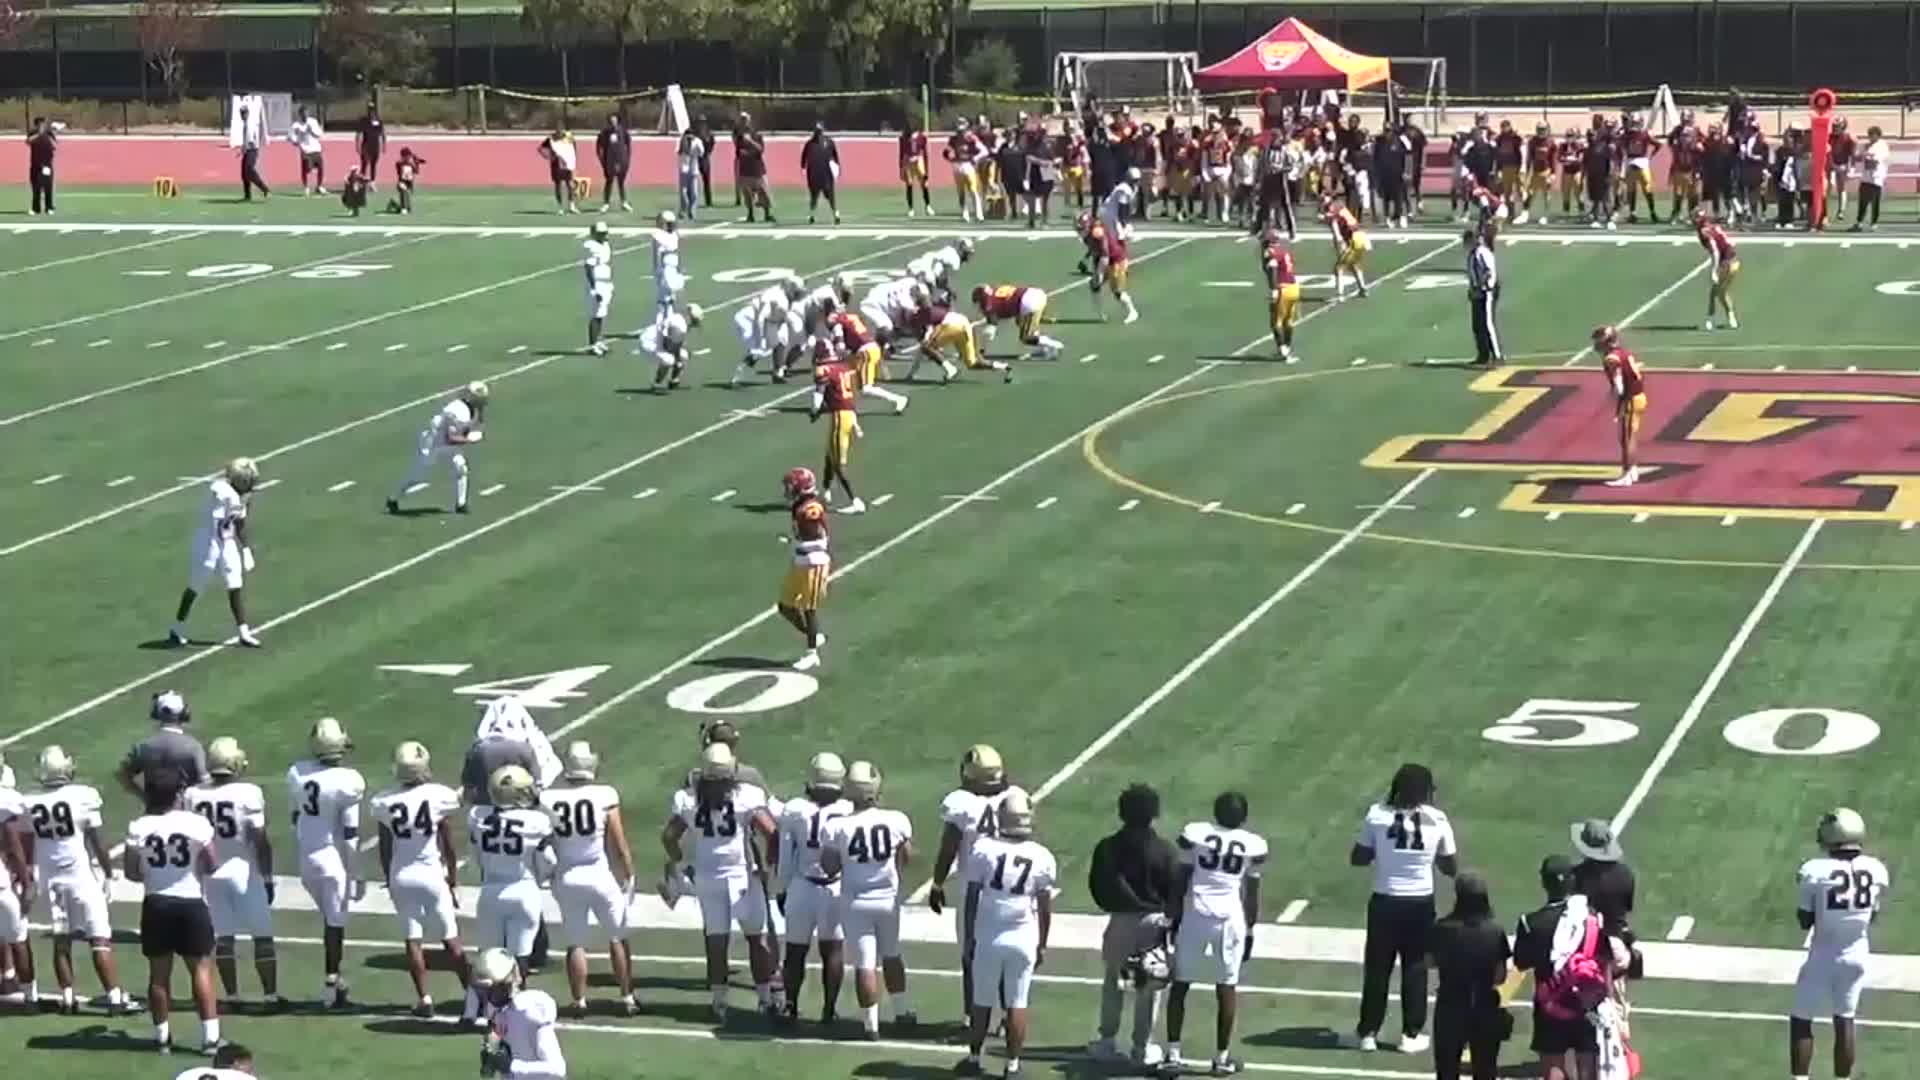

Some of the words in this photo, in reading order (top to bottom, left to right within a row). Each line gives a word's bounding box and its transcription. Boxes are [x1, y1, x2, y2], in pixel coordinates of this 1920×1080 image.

[156, 179, 170, 197] 10
[453, 664, 820, 714] 40
[1481, 698, 1880, 756] 50
[303, 780, 321, 817] 3
[553, 799, 596, 838] 30
[30, 801, 75, 840] 29
[388, 800, 433, 839] 24
[481, 814, 524, 857] 25
[694, 799, 737, 839] 43
[1386, 811, 1425, 850] 41
[145, 833, 191, 869] 33
[848, 823, 892, 865] 40
[1198, 834, 1246, 875] 36
[990, 852, 1033, 894] 17
[1826, 869, 1873, 910] 28
